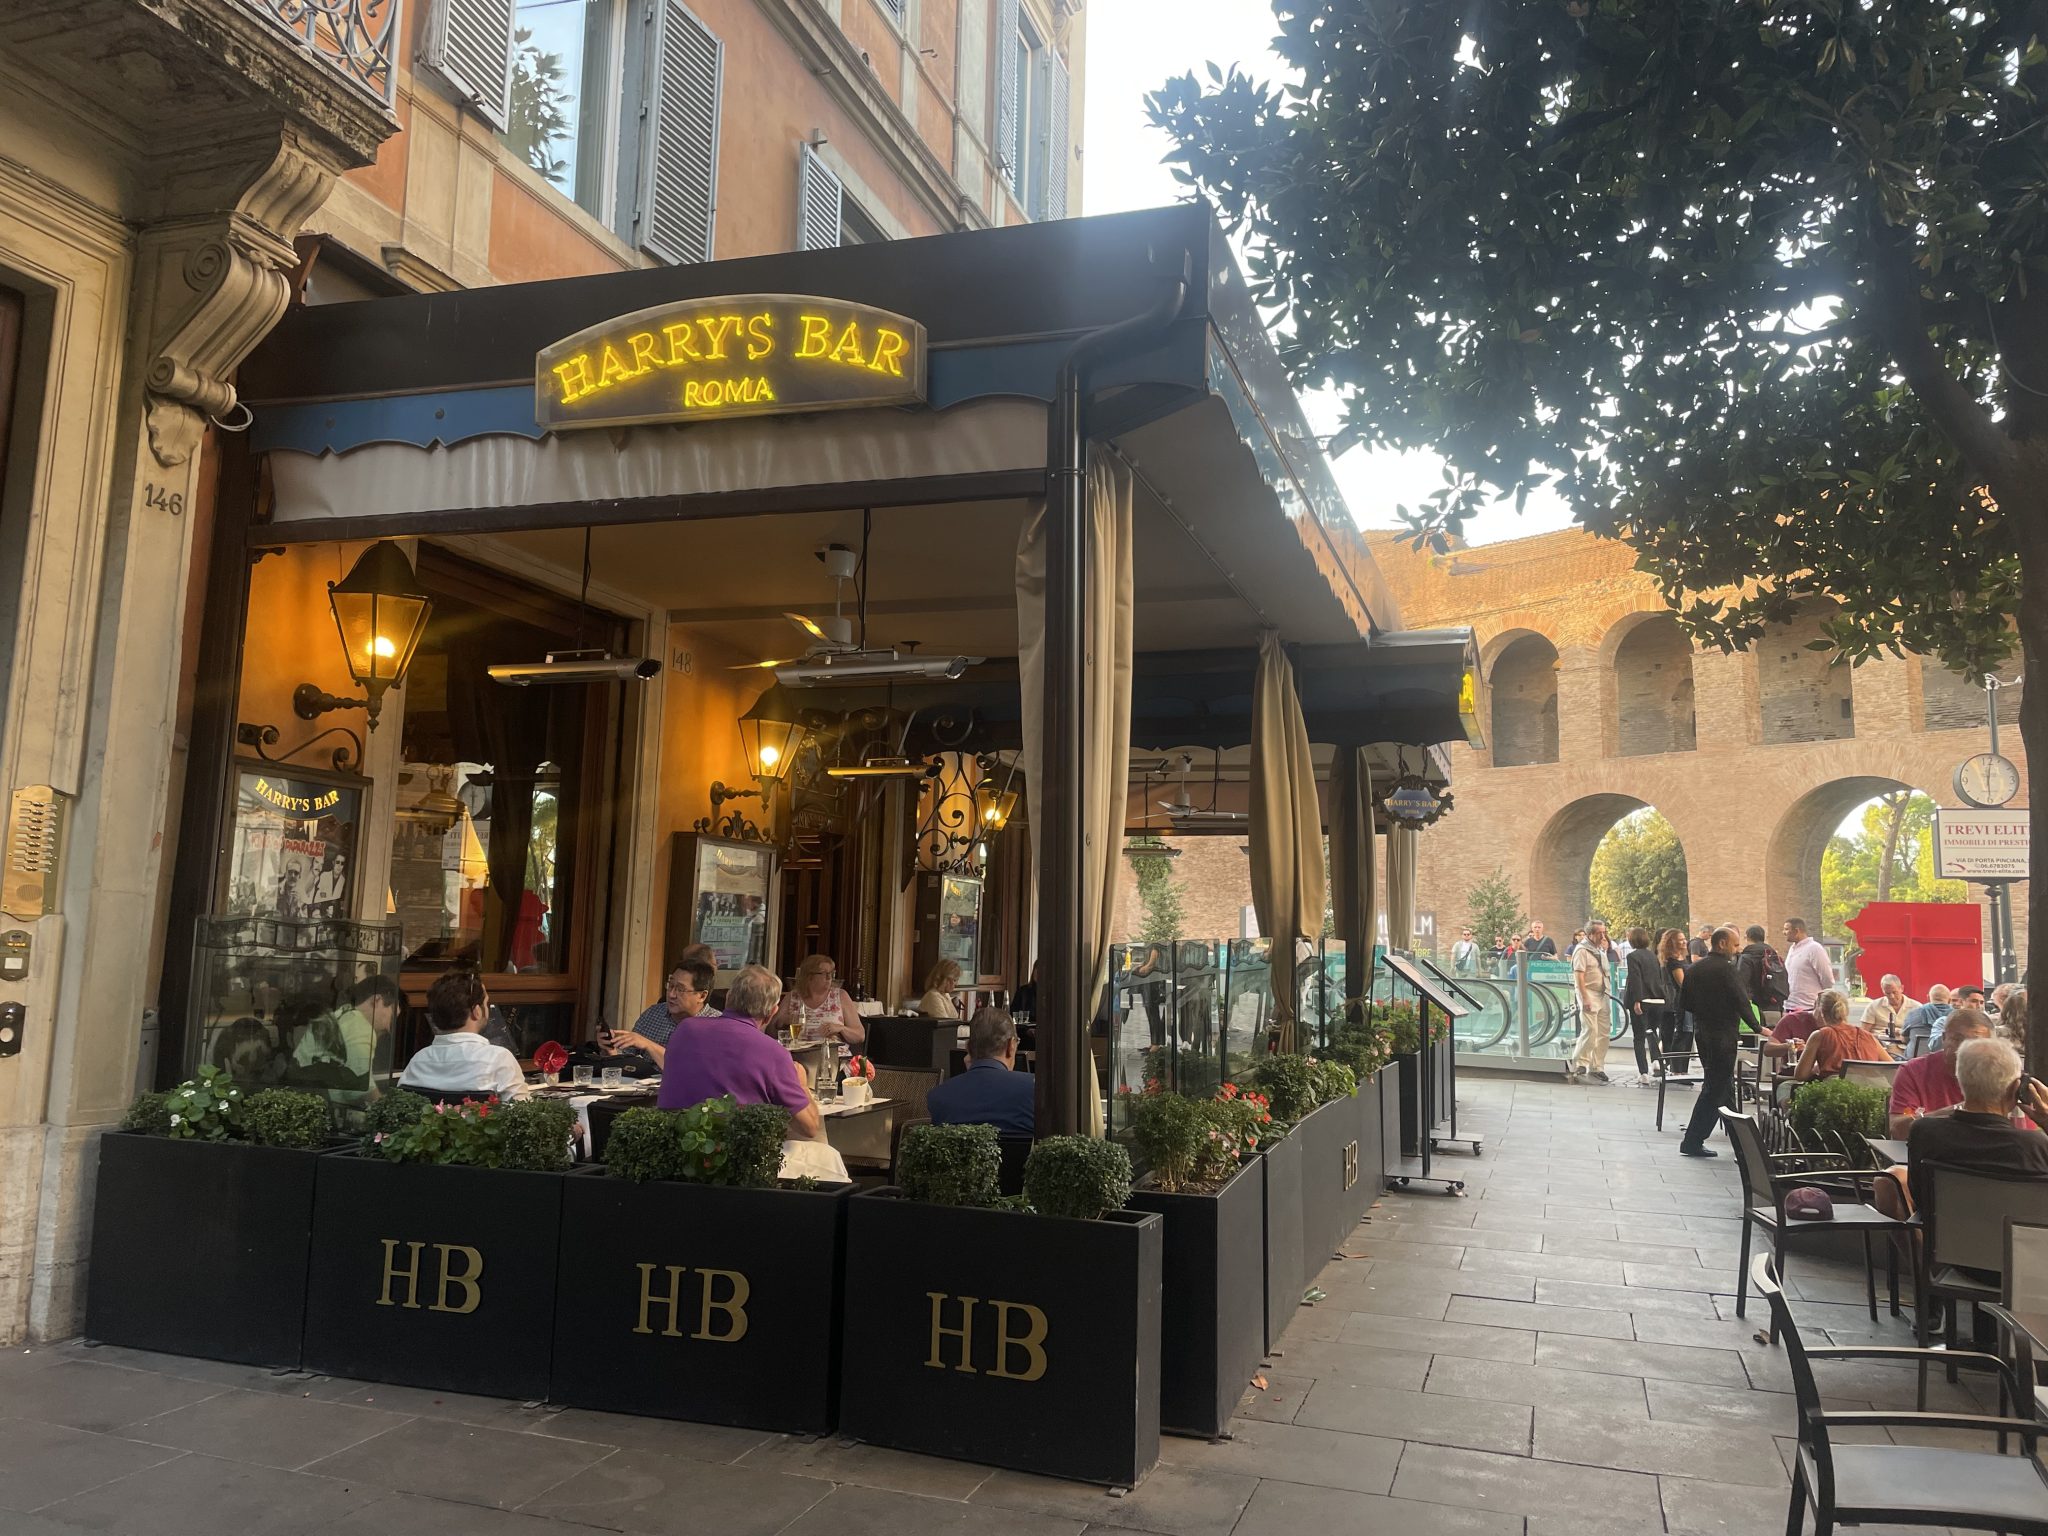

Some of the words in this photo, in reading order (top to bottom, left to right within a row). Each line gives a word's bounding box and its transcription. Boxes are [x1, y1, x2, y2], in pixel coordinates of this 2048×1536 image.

[553, 313, 774, 404] HARRY'S
[794, 315, 907, 377] BAR
[684, 377, 775, 407] ROMA
[145, 483, 183, 516] 146
[671, 647, 692, 674] 148
[1982, 757, 1994, 766] 12
[255, 778, 310, 812] HARRY'S
[313, 789, 340, 811] BAR
[2009, 775, 2016, 785] 3
[1387, 799, 1420, 808] HARRY'S
[1421, 800, 1439, 808] BAR
[1944, 825, 1990, 836] TREVI
[1994, 825, 2029, 836] ELIT
[1413, 938, 1422, 948] 27
[1343, 1139, 1358, 1191] HB
[375, 1238, 484, 1314] HB
[632, 1262, 751, 1343] HB
[924, 1291, 1049, 1382] HB
